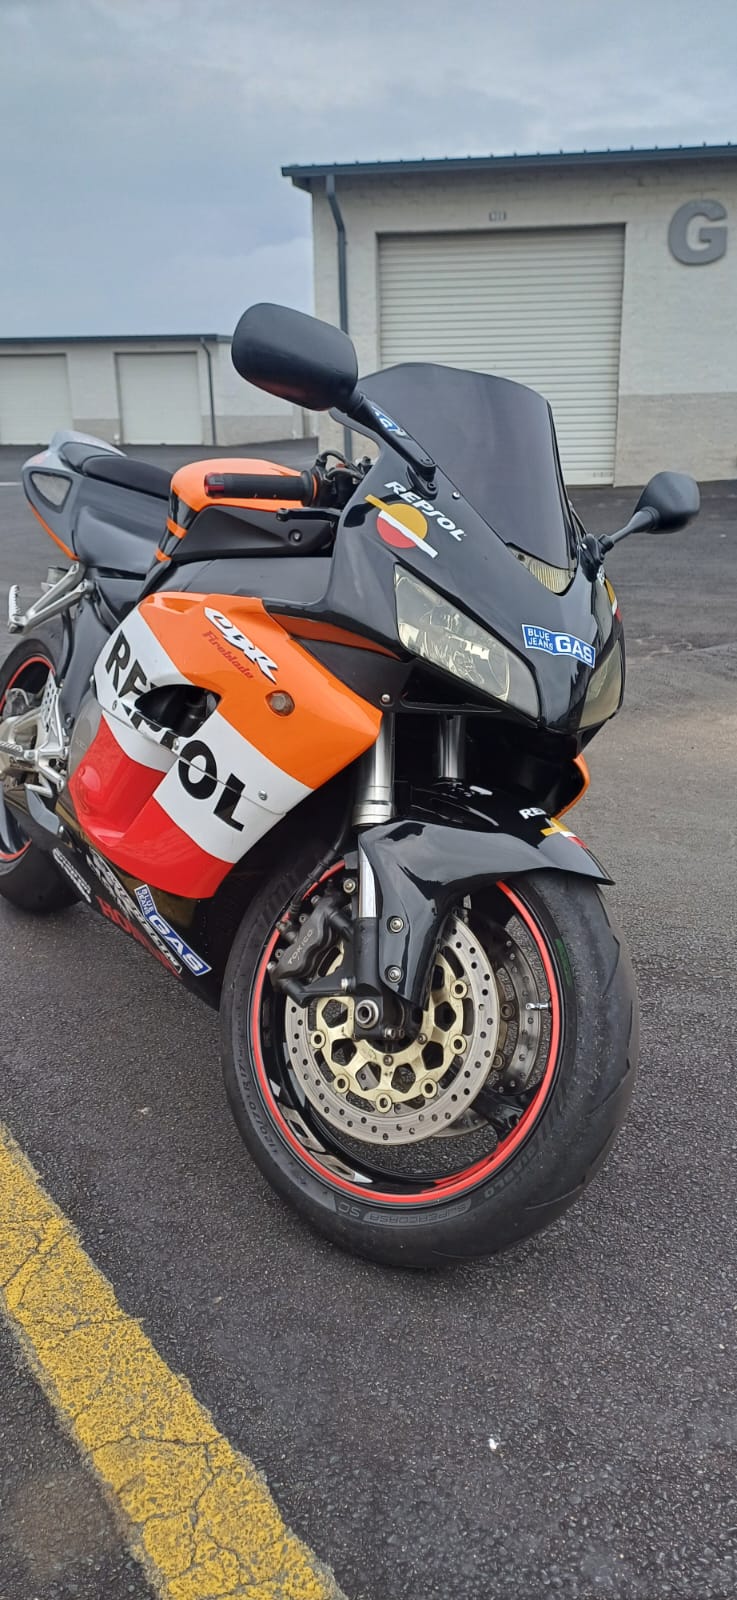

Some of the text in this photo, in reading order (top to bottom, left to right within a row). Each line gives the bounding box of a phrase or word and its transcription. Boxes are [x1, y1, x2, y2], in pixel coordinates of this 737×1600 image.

[667, 199, 728, 267] G
[384, 481, 467, 542] REPSOL
[203, 607, 279, 685] CBR
[203, 631, 254, 679] Fireblade
[527, 628, 551, 641] BLUE
[528, 637, 554, 650] JEANS
[555, 635, 593, 664] GAS
[148, 914, 204, 972] GAS
[287, 929, 313, 965] TOKICO
[368, 1203, 467, 1225] SUPERCORSA
